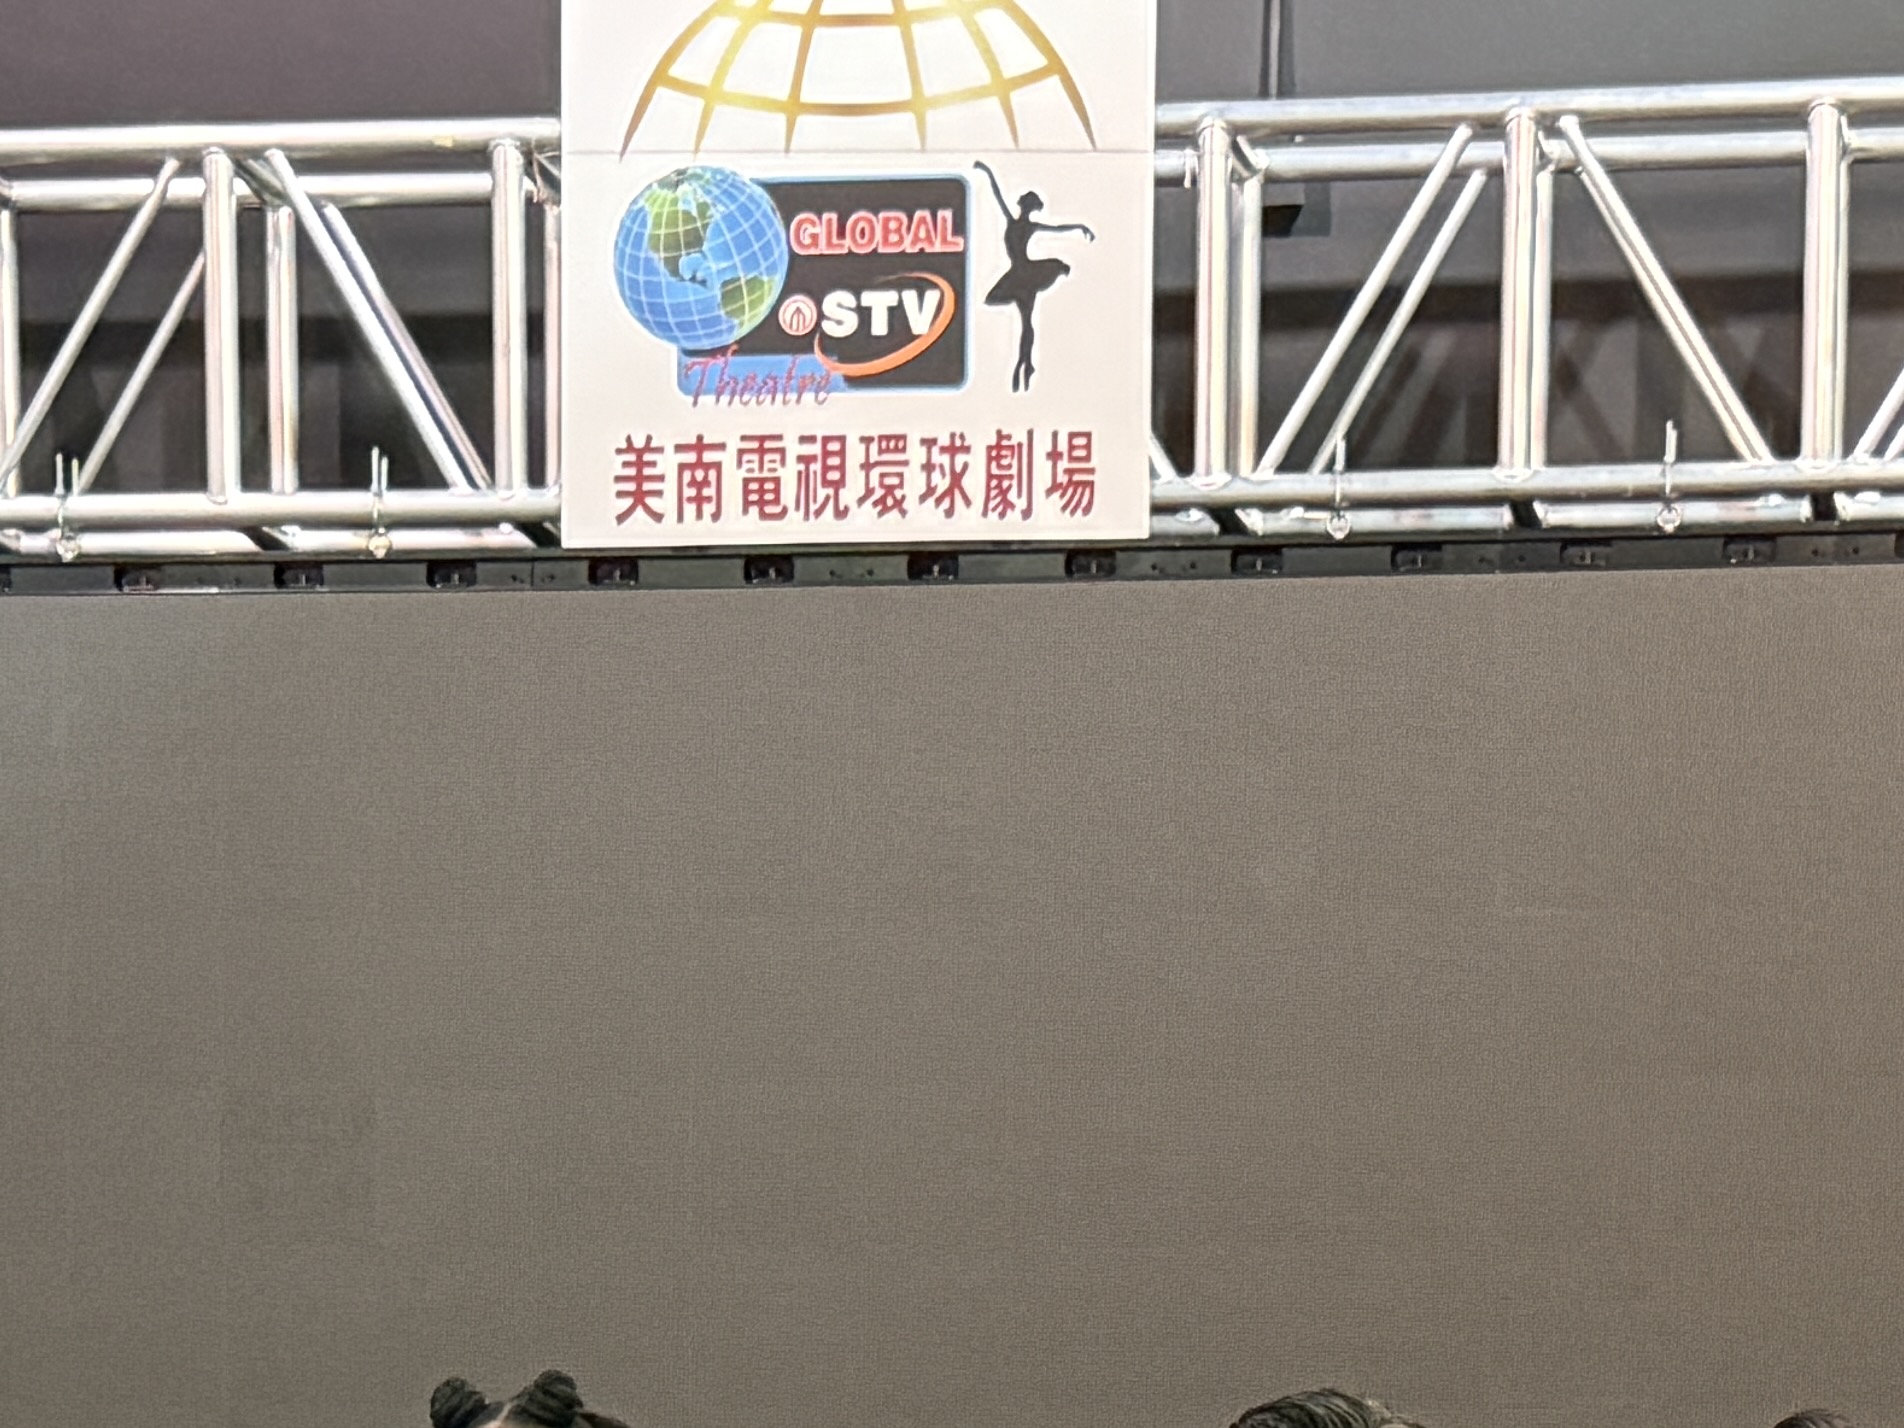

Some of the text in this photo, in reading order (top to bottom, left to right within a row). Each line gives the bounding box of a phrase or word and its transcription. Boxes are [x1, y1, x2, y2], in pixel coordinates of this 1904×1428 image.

[790, 210, 964, 254] GLOBAL
[821, 289, 941, 336] STV
[684, 343, 832, 408] Theatre
[613, 428, 1096, 526] 美南電視環球劇場
